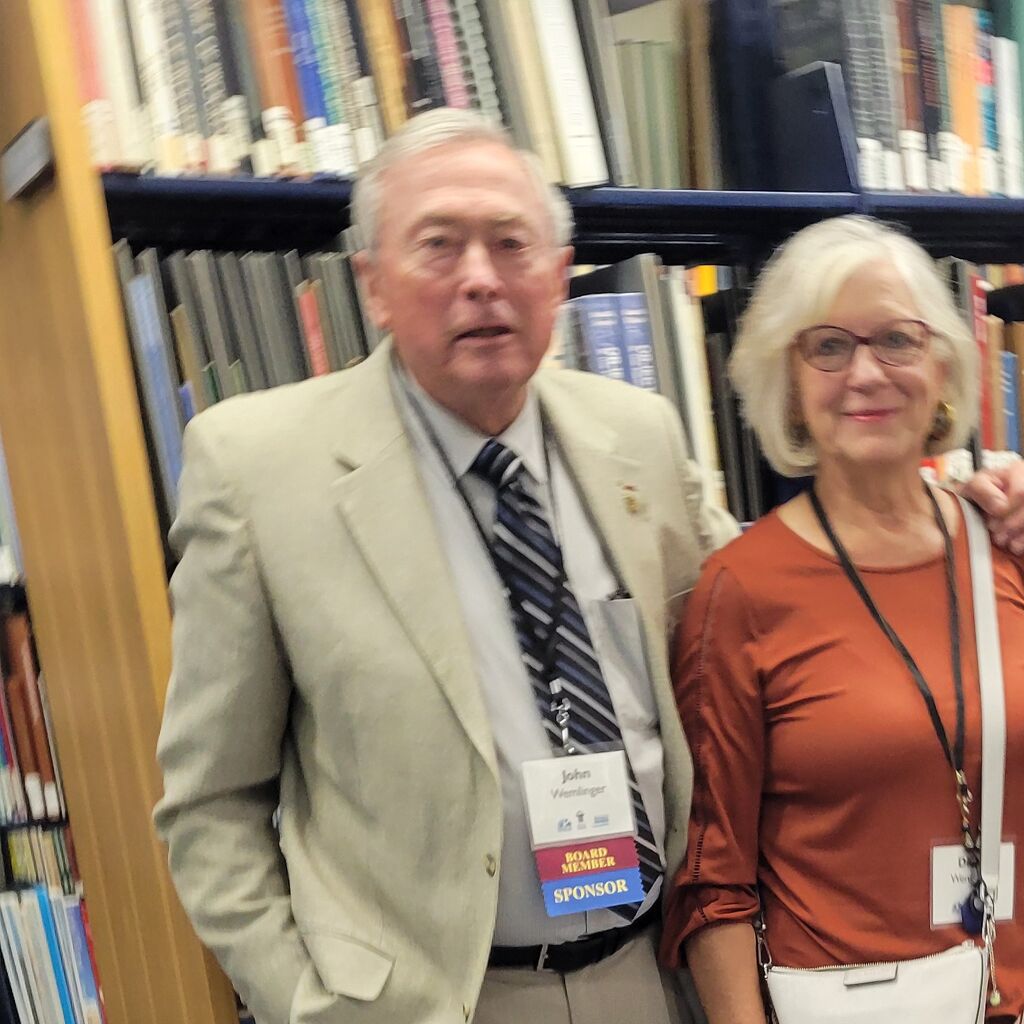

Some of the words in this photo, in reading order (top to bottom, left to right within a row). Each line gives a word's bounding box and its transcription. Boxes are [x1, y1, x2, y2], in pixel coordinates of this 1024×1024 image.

[562, 768, 591, 785] John
[565, 847, 608, 863] BOARD
[561, 856, 616, 874] MEMBER
[553, 879, 629, 904] SPONSOR
